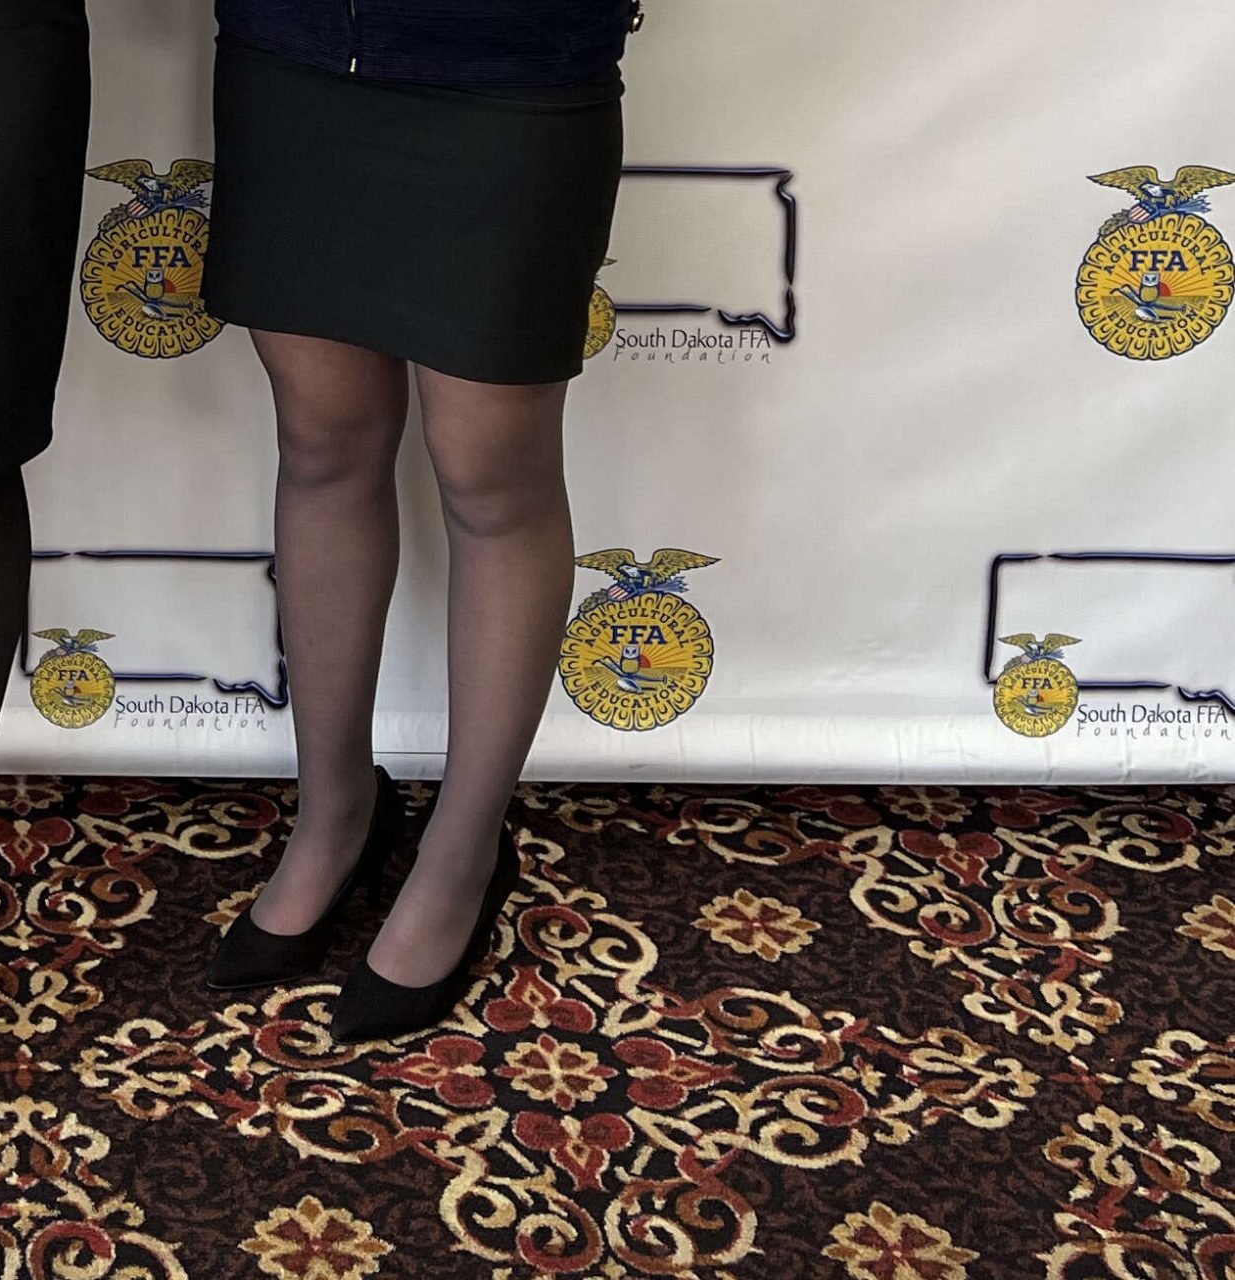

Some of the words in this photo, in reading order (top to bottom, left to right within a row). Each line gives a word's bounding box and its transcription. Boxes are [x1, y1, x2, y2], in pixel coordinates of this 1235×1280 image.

[132, 246, 192, 268] FFA
[1104, 230, 1212, 276] AGRICULTURAL
[1129, 250, 1188, 272] FFA
[114, 307, 205, 336] EDUCATION
[1107, 307, 1199, 339] EDUCATION
[616, 328, 665, 349] South
[671, 328, 734, 350] Dakota
[739, 329, 772, 349] FFA
[614, 345, 772, 365] Foundation
[584, 607, 690, 648] AGRICULTURAL
[609, 624, 668, 645] FFA
[59, 669, 89, 681] FFA
[1021, 677, 1053, 690] FFA
[114, 694, 165, 714] South
[169, 695, 229, 716] Dakota
[234, 696, 266, 714] FFA
[590, 679, 680, 709] EDUCATION
[114, 712, 267, 731] Foundation
[1076, 702, 1126, 724] South
[1132, 703, 1191, 725] Dakota
[1197, 705, 1228, 724] FFA
[1076, 720, 1232, 740] Foundation
